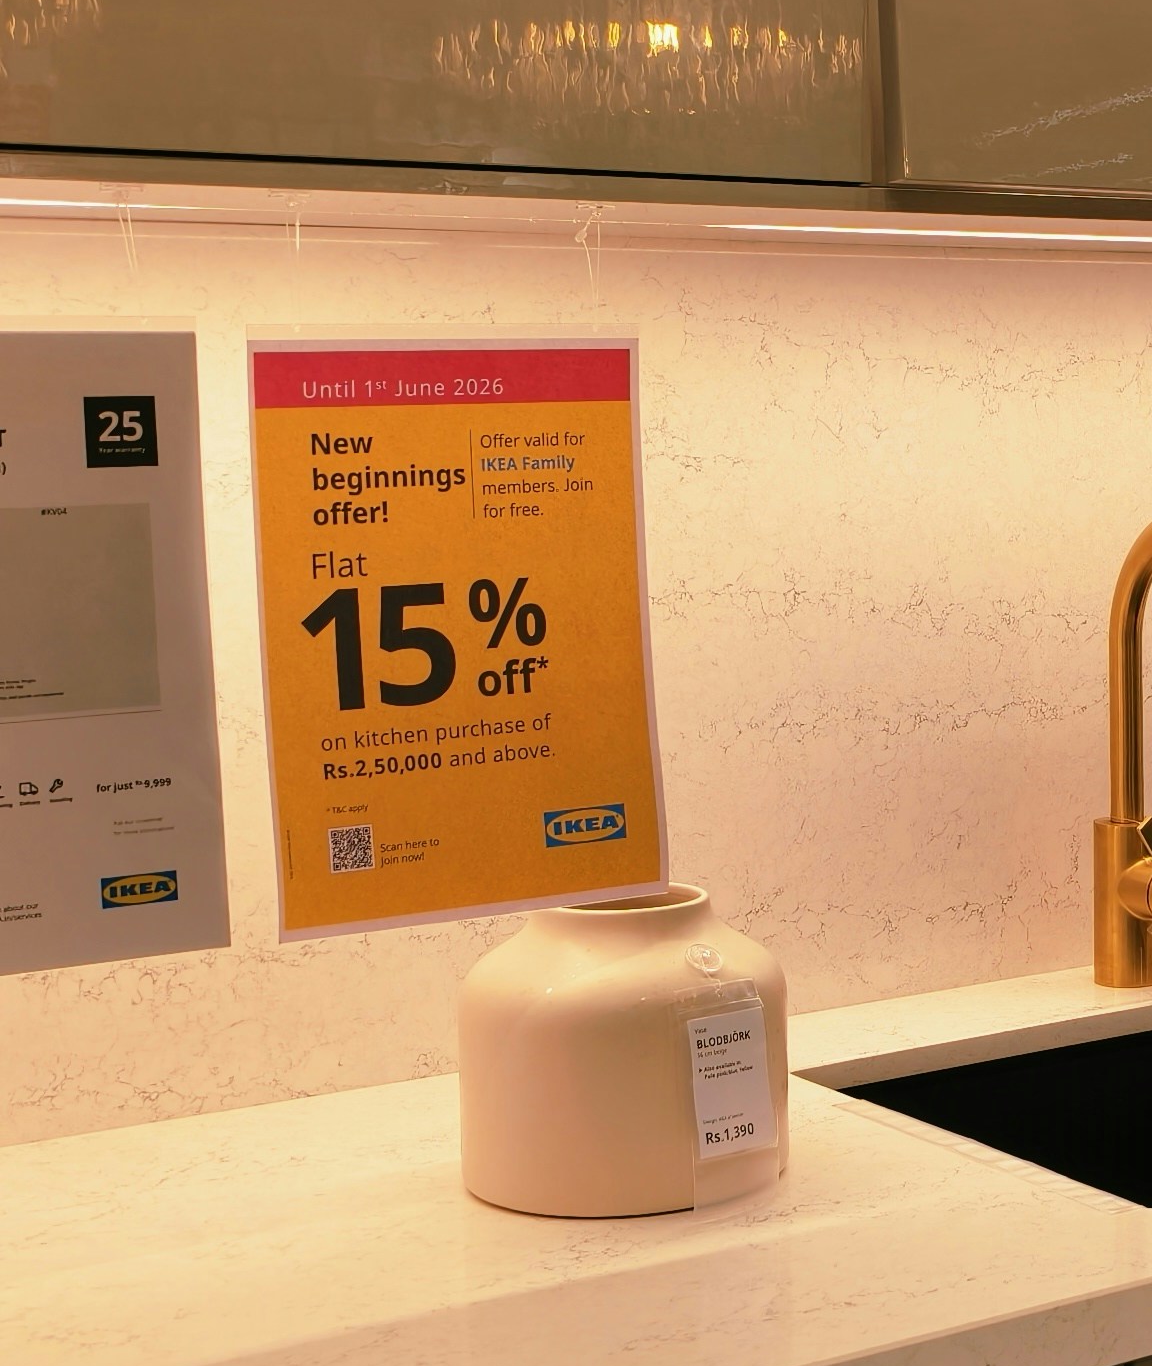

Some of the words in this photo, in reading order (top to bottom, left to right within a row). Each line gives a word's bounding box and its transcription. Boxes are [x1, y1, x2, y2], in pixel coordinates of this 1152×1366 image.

[302, 380, 355, 399] Until
[365, 380, 386, 397] 1st
[395, 380, 445, 397] June
[454, 378, 503, 395] 2026
[99, 411, 143, 441] 25
[311, 433, 372, 455] New
[480, 434, 519, 448] Offer
[524, 433, 559, 446] valid
[564, 432, 585, 445] for
[481, 458, 517, 471] IKEA
[523, 455, 575, 472] Family
[313, 465, 465, 495] beginnings
[483, 480, 559, 494] members.
[563, 478, 593, 492] Join
[313, 501, 388, 525] offer!
[484, 504, 504, 518] for
[510, 503, 544, 517] free.
[312, 551, 368, 579] Flat
[321, 736, 346, 751] on
[354, 727, 428, 748] kitchen
[436, 719, 525, 745] purchase
[532, 713, 551, 731] of
[323, 753, 442, 780] Rs.2,50,000
[449, 747, 485, 767] and
[494, 742, 555, 762] above.
[97, 784, 111, 792] for
[114, 782, 133, 793] just
[349, 804, 368, 813] apply
[553, 815, 618, 835] IKEA
[380, 843, 402, 852] Scan
[406, 840, 427, 849] here
[430, 838, 439, 846] to
[402, 852, 424, 862] now!
[110, 881, 171, 898] IKEA
[697, 1030, 750, 1049] BLODBJÖRK
[706, 1122, 754, 1144] Rs.1,390
